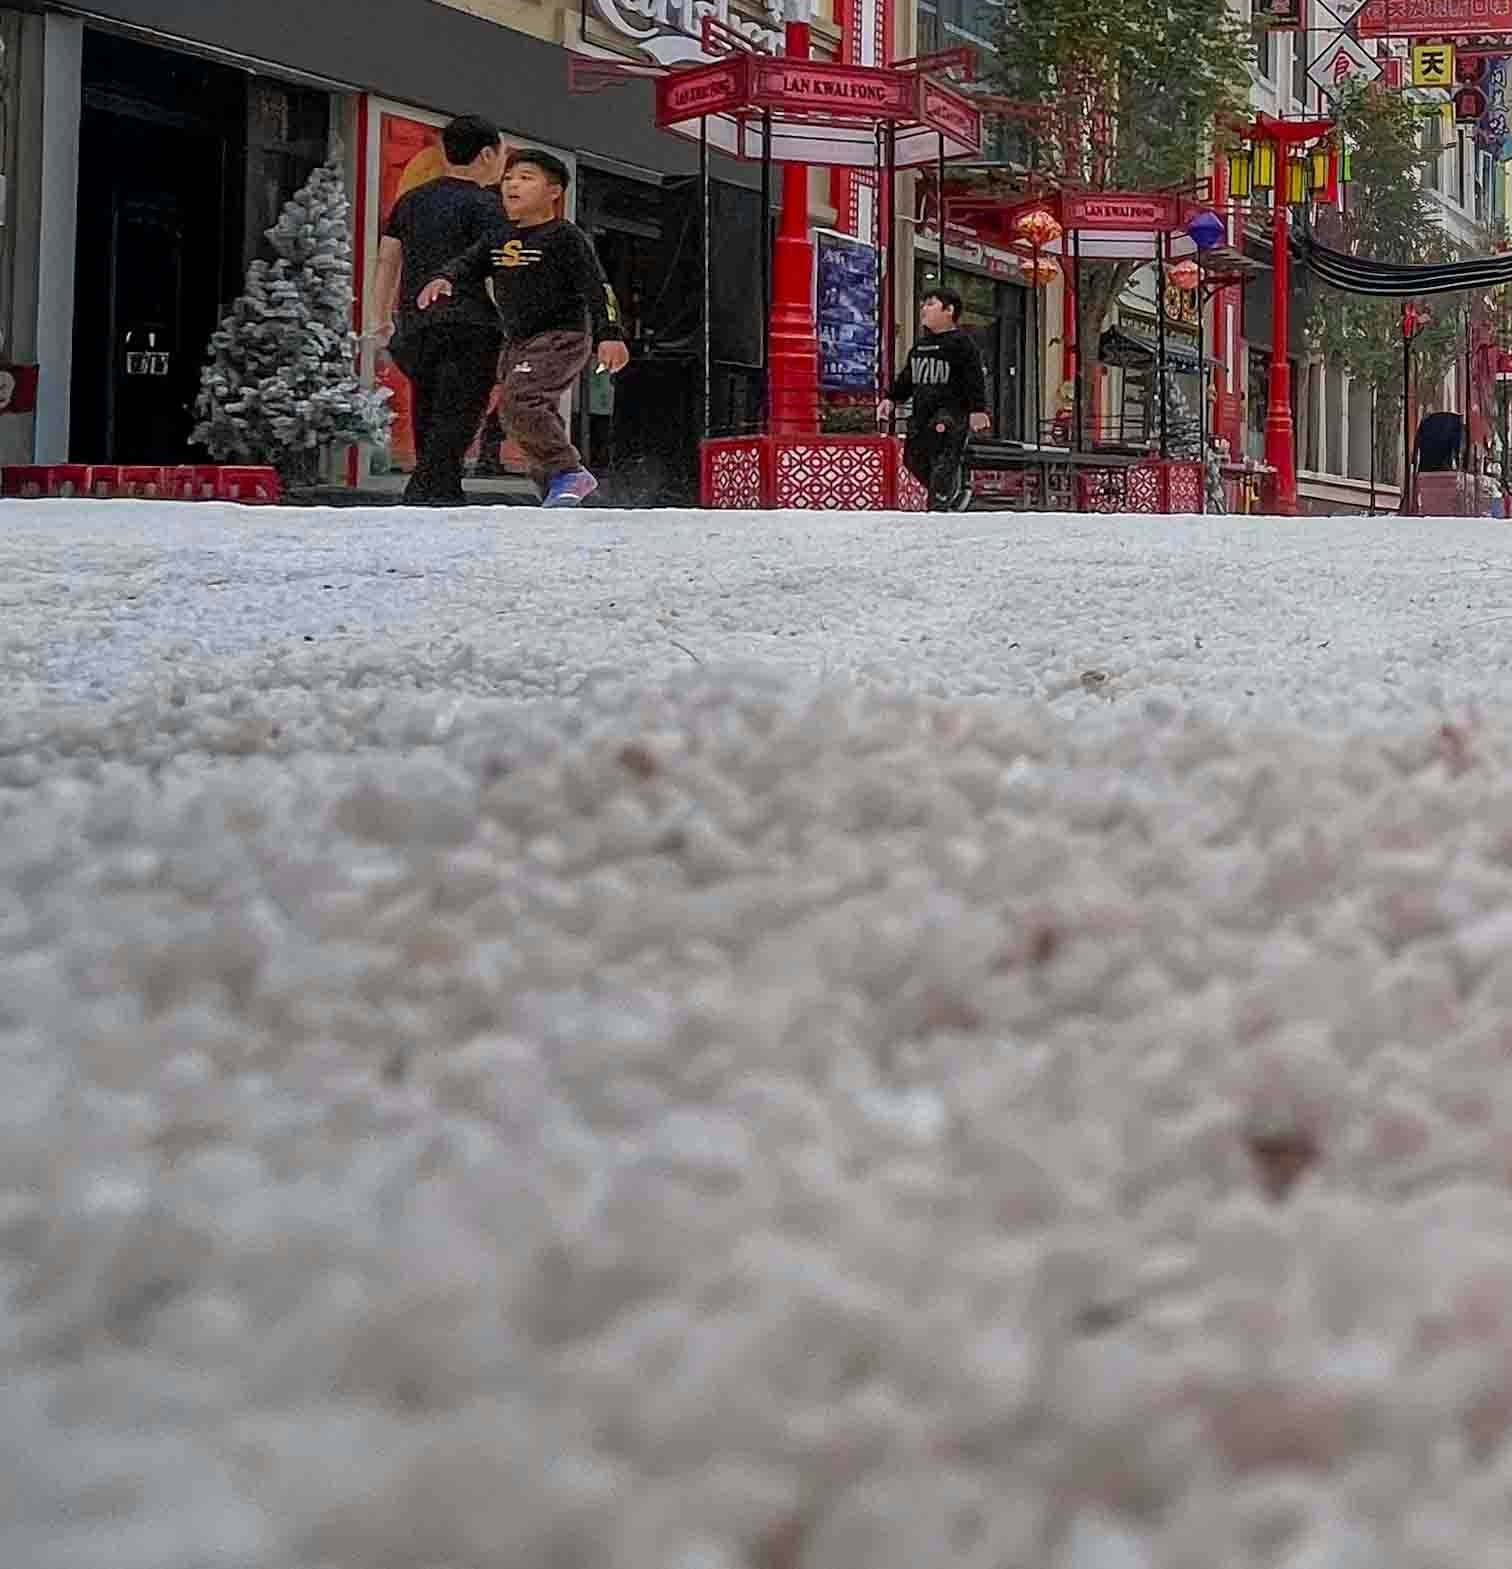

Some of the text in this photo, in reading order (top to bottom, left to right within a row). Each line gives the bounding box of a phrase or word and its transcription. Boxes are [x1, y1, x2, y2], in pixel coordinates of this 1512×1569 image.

[1420, 51, 1444, 76] 天
[783, 76, 887, 101] LAN KWAI FONG
